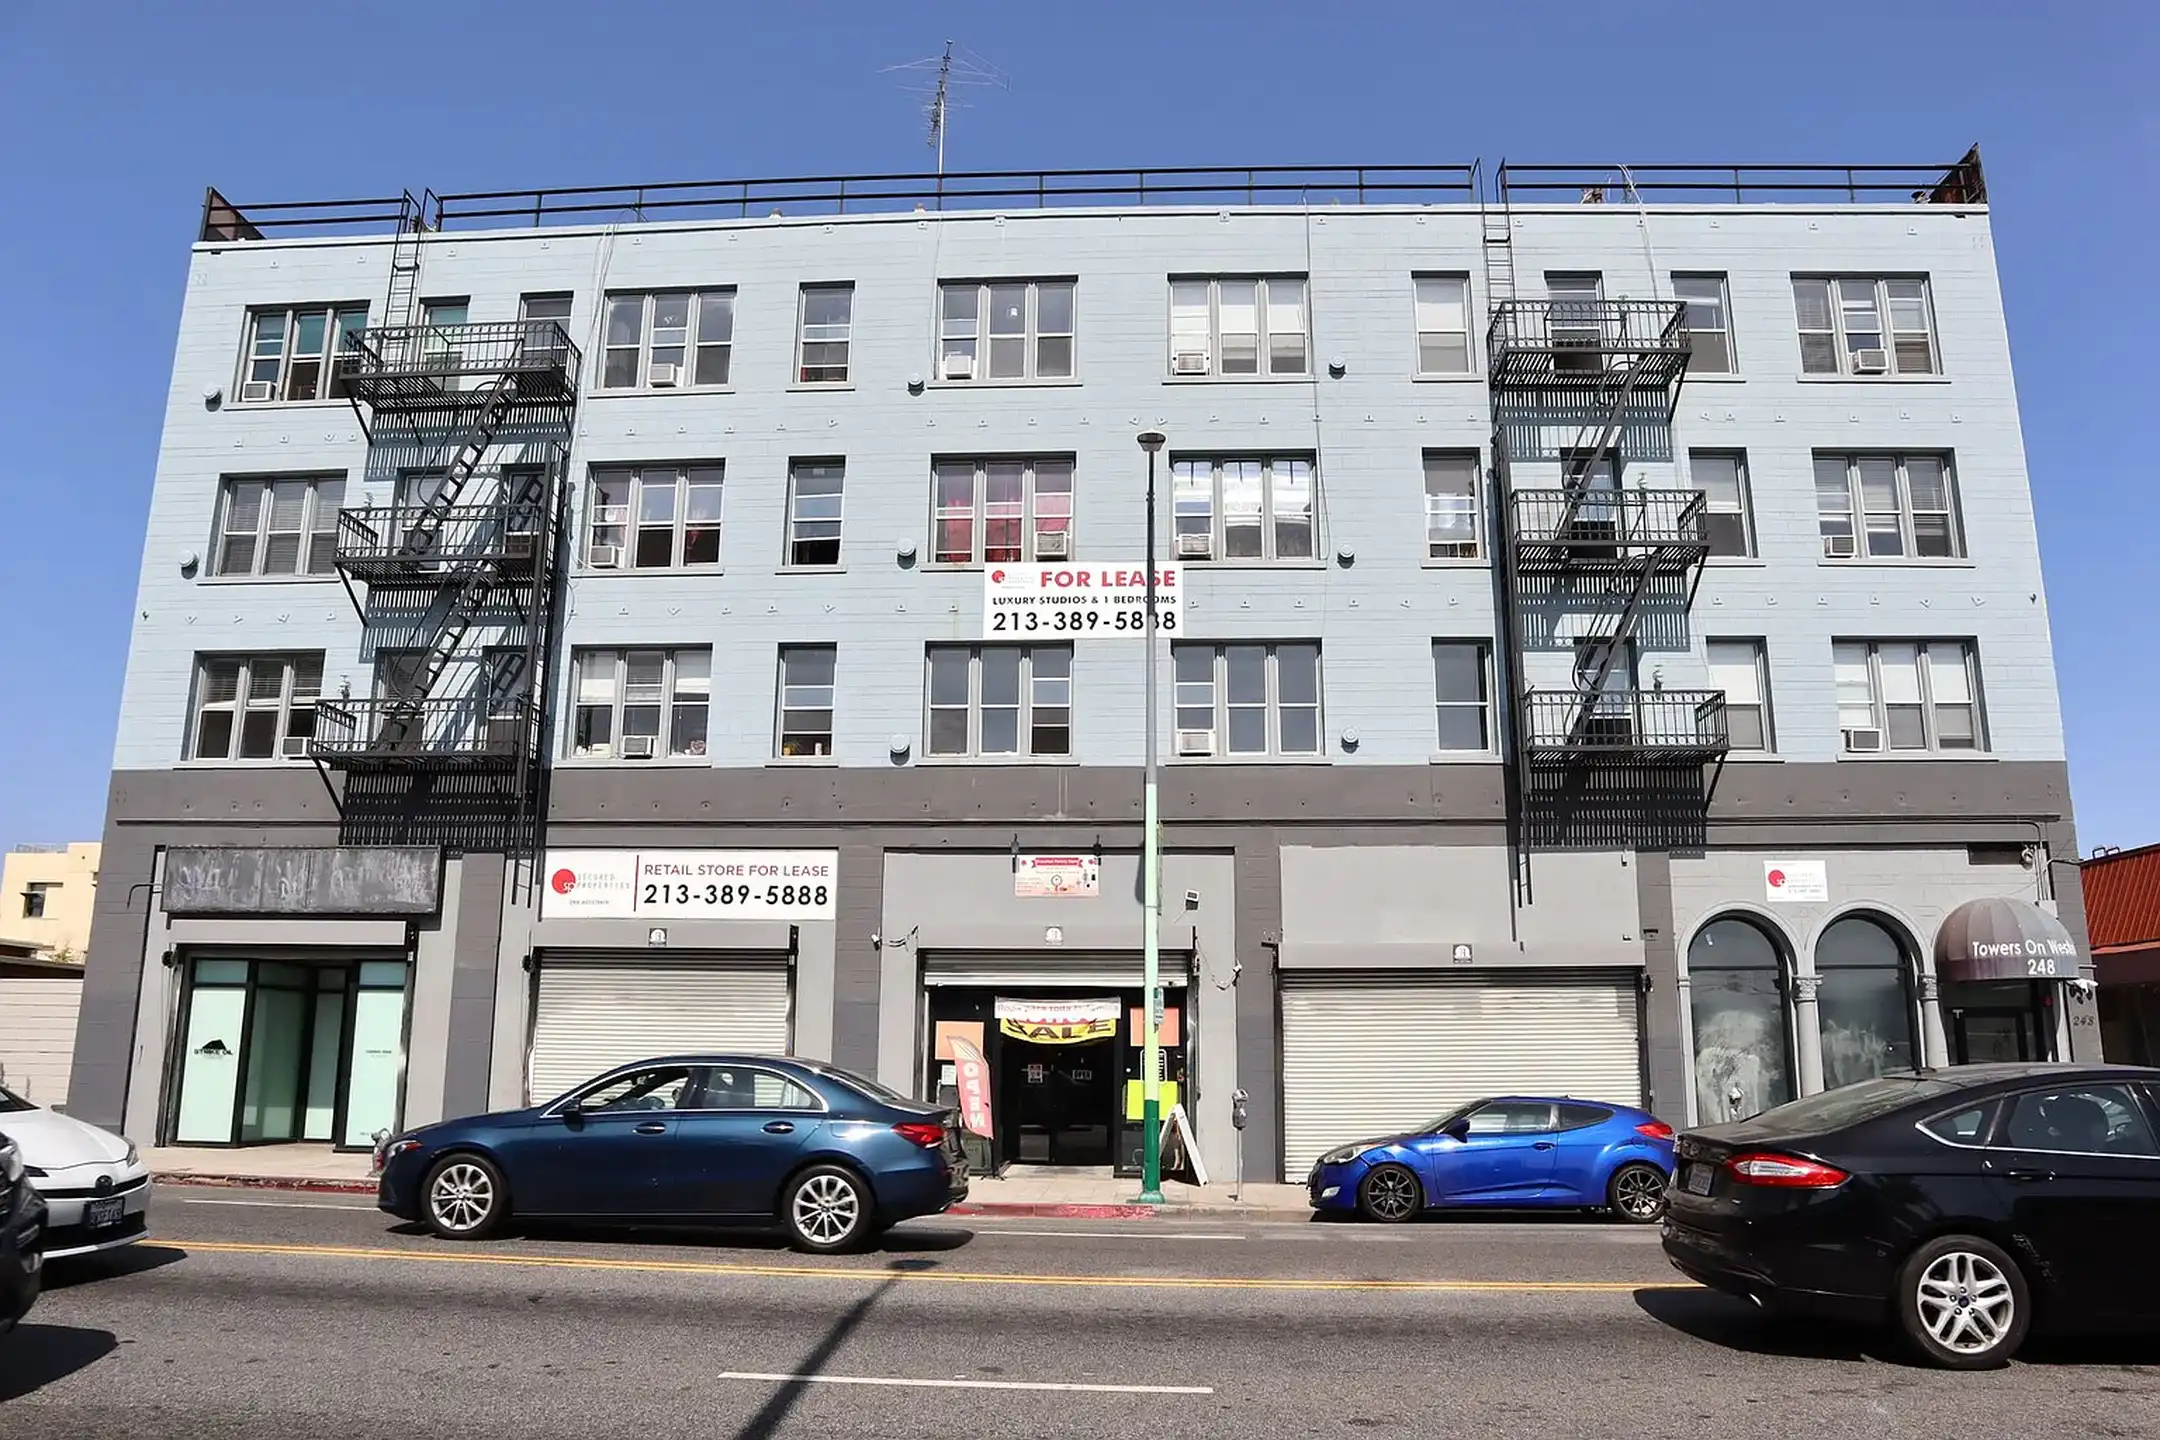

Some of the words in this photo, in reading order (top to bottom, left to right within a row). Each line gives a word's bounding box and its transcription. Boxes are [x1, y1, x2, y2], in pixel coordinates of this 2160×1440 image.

[1041, 571, 1090, 588] FOR
[1101, 570, 1176, 587] LEASE
[993, 596, 1036, 605] LUXURY
[1039, 595, 1087, 604] STUDIOS
[1091, 596, 1099, 604] &
[1114, 595, 1177, 604] BEDROOMS
[644, 864, 693, 876] RETAIL
[698, 864, 745, 876] STORE
[748, 865, 779, 876] FOR
[783, 865, 829, 877] LEASE
[643, 884, 828, 906] 213-389-5888
[1972, 941, 2022, 957] Towers
[2025, 939, 2046, 955] On
[2027, 958, 2056, 976] 248
[1006, 1018, 1112, 1039] SALE
[963, 1061, 986, 1129] OPEN
